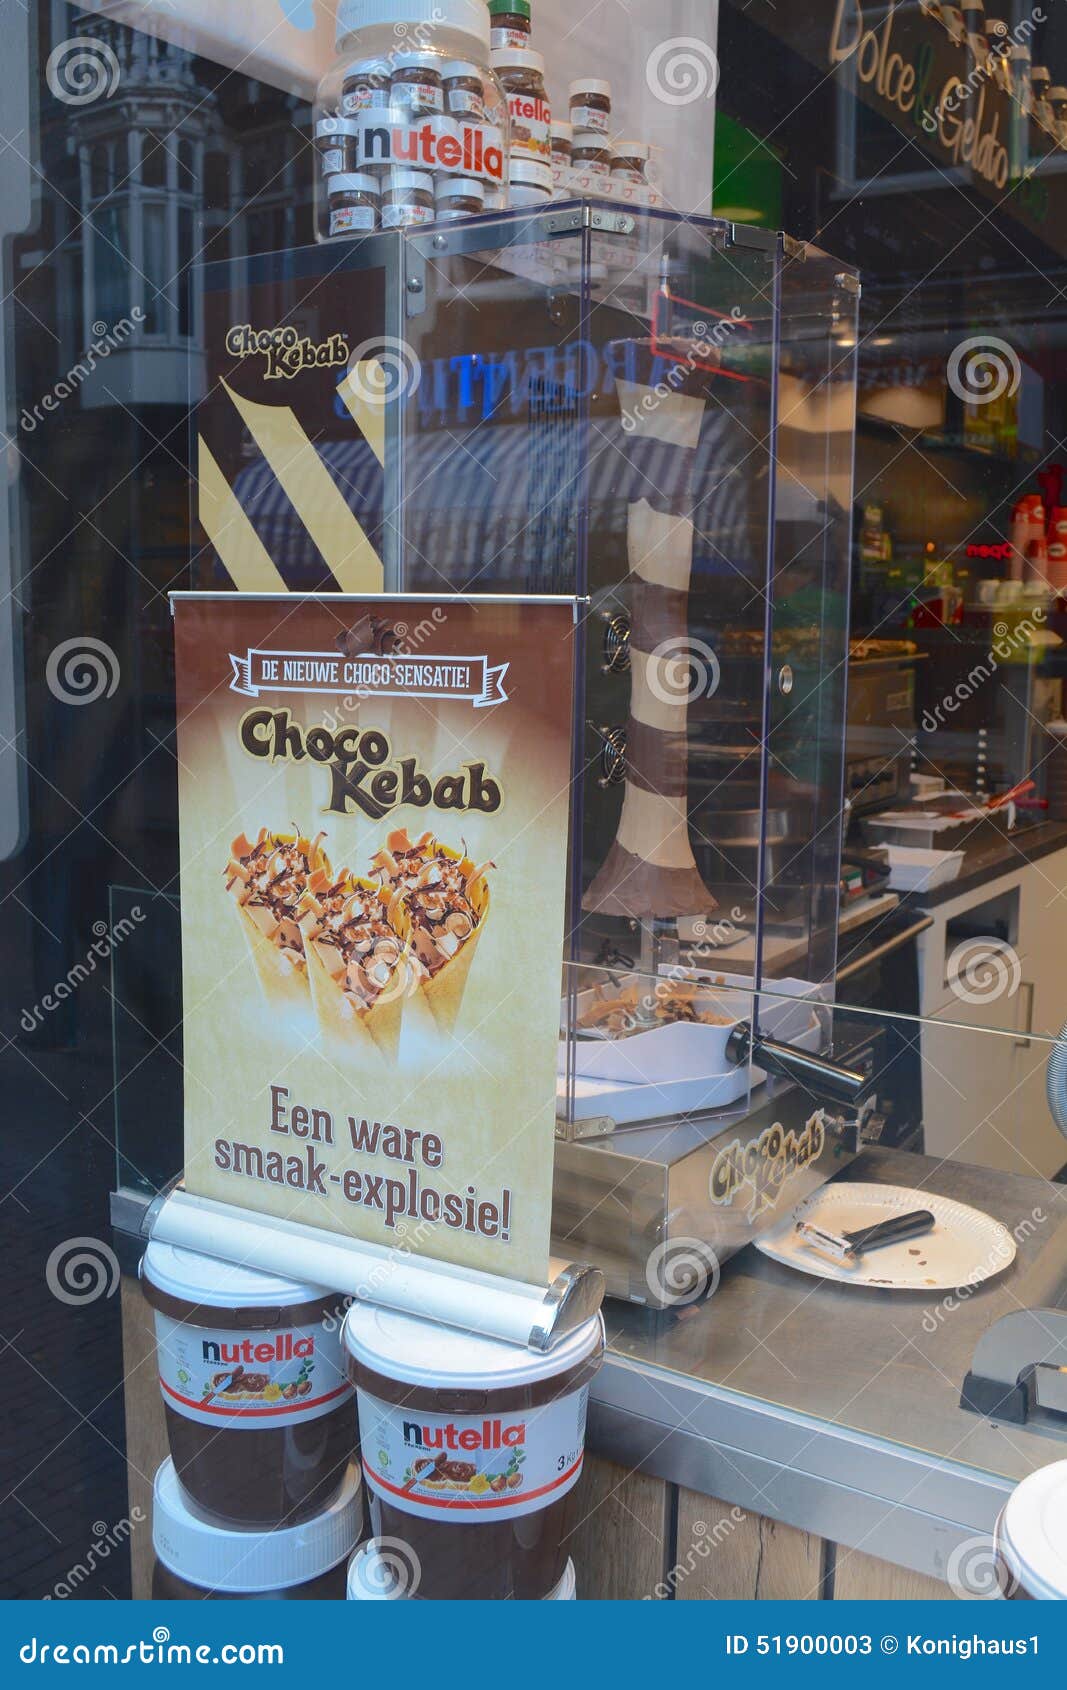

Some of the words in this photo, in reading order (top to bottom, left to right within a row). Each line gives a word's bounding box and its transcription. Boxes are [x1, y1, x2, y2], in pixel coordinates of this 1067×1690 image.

[828, 0, 916, 112] Dolce
[938, 76, 1009, 189] Gelato
[363, 124, 503, 180] nutella
[226, 324, 298, 358] Choco
[264, 334, 349, 380] Kebab
[261, 660, 279, 682] DE
[283, 661, 339, 684] NIEUWE
[343, 664, 471, 689] CHOCO-SENSATIE!
[239, 708, 390, 766] Choco
[321, 757, 503, 820] Kebab
[269, 1084, 334, 1145] Een
[347, 1116, 444, 1169] ware
[214, 1138, 512, 1242] smaak-explosie!
[202, 1333, 316, 1364] nutella
[403, 1420, 527, 1451] nutella
[557, 1455, 565, 1471] 3
